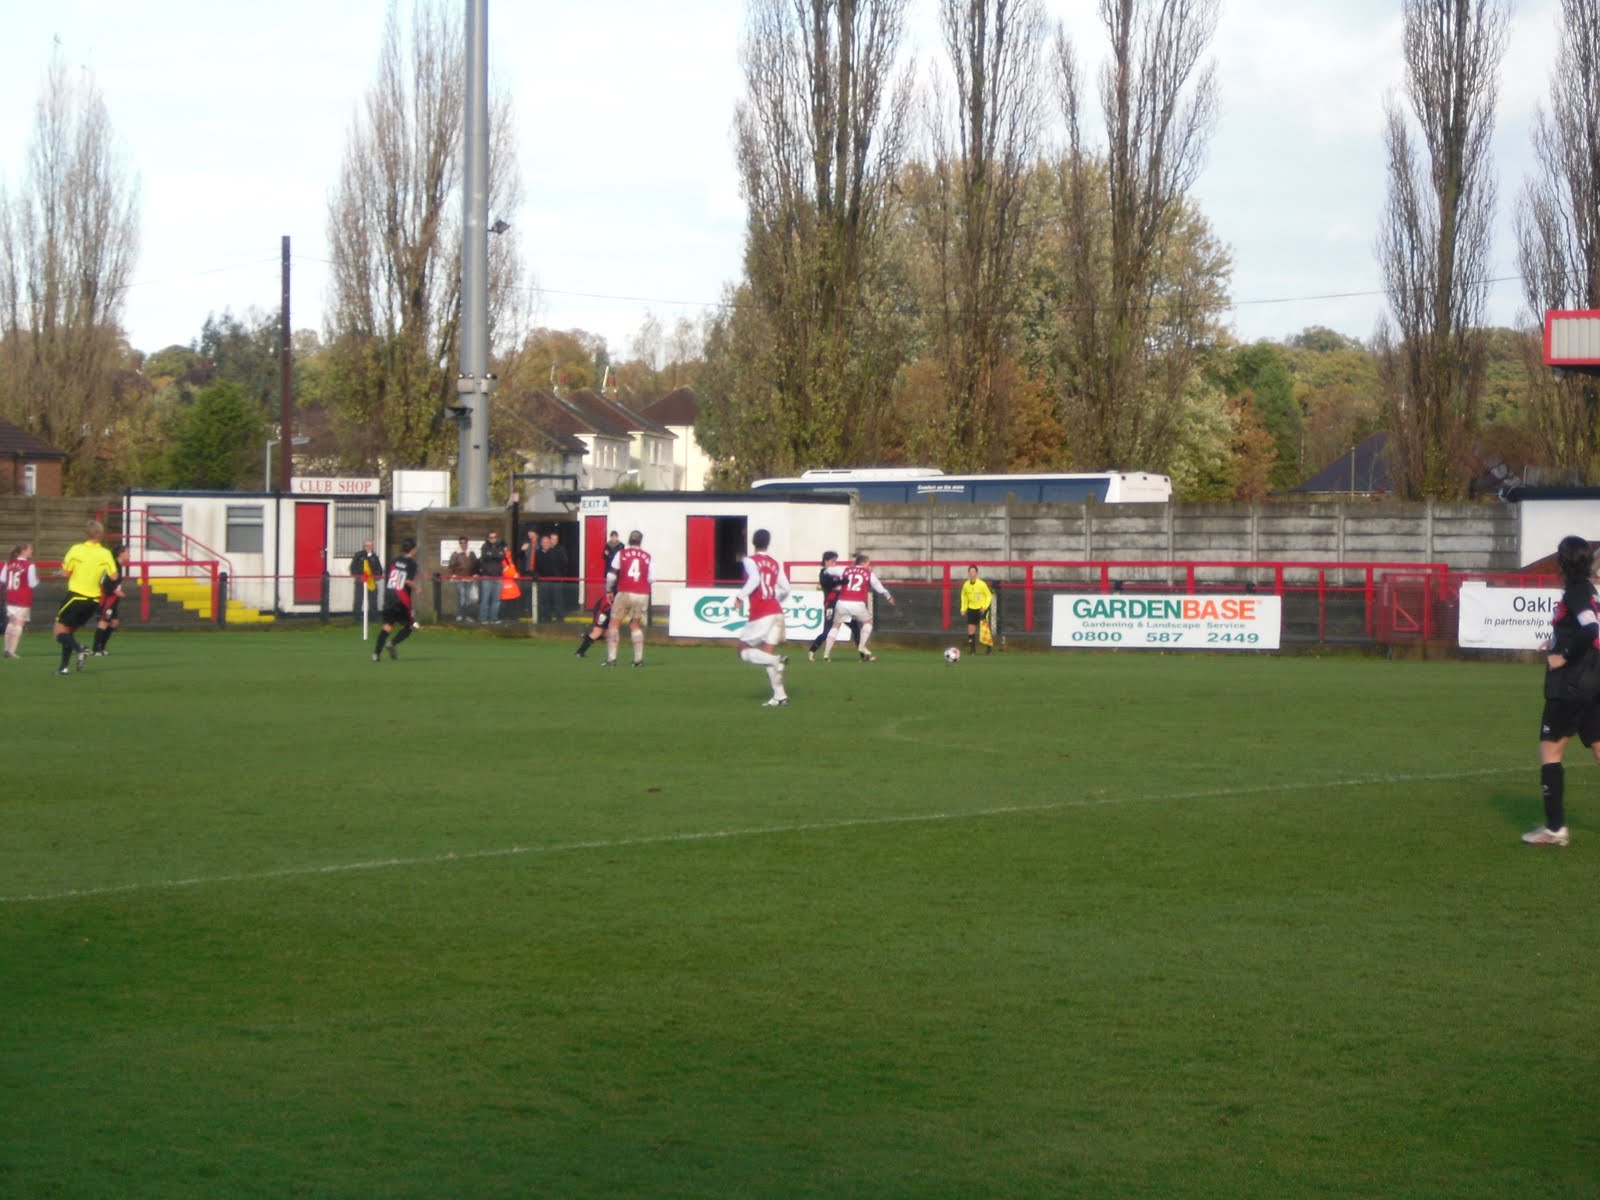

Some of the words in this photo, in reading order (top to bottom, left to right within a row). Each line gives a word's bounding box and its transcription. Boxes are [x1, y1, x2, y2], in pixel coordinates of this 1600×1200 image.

[299, 479, 332, 493] CLUB
[338, 480, 372, 493] SHOP
[582, 500, 600, 509] EXIT
[602, 500, 609, 508] A
[627, 558, 641, 582] 4
[8, 571, 20, 590] 16
[387, 569, 407, 591] 20
[760, 571, 774, 600] 11
[847, 573, 864, 592] 12
[694, 596, 823, 630] Carlerg
[1072, 598, 1256, 620] GARDENBASE
[1484, 617, 1493, 626] in
[1494, 618, 1545, 629] partnership
[1072, 631, 1122, 641] 0800
[1146, 633, 1183, 642] 587
[1207, 633, 1259, 643] 2449
